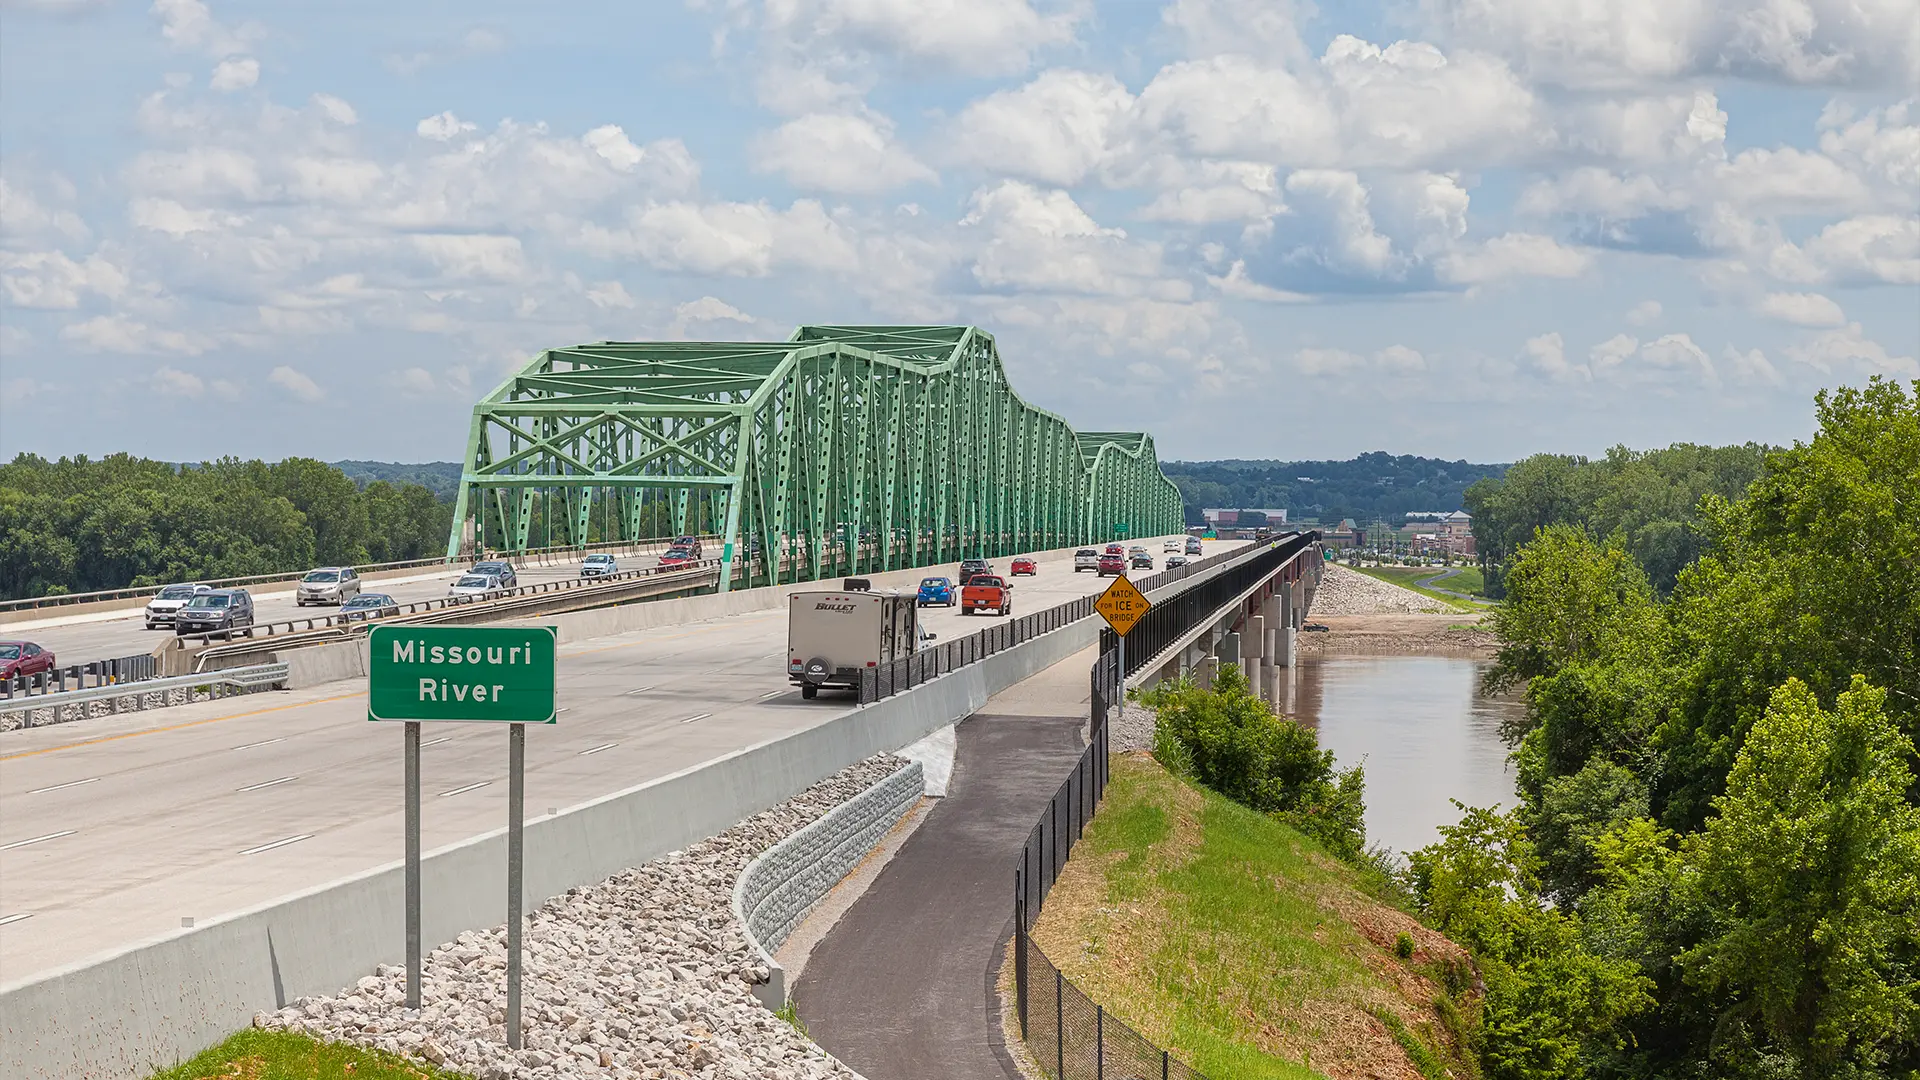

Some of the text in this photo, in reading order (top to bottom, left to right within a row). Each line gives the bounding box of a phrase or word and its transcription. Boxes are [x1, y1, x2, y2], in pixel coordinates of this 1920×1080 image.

[1111, 590, 1134, 598] WATCH
[814, 602, 857, 610] BULLET
[1115, 601, 1132, 611] ICE
[393, 640, 531, 664] Missouri
[419, 678, 504, 702] River
